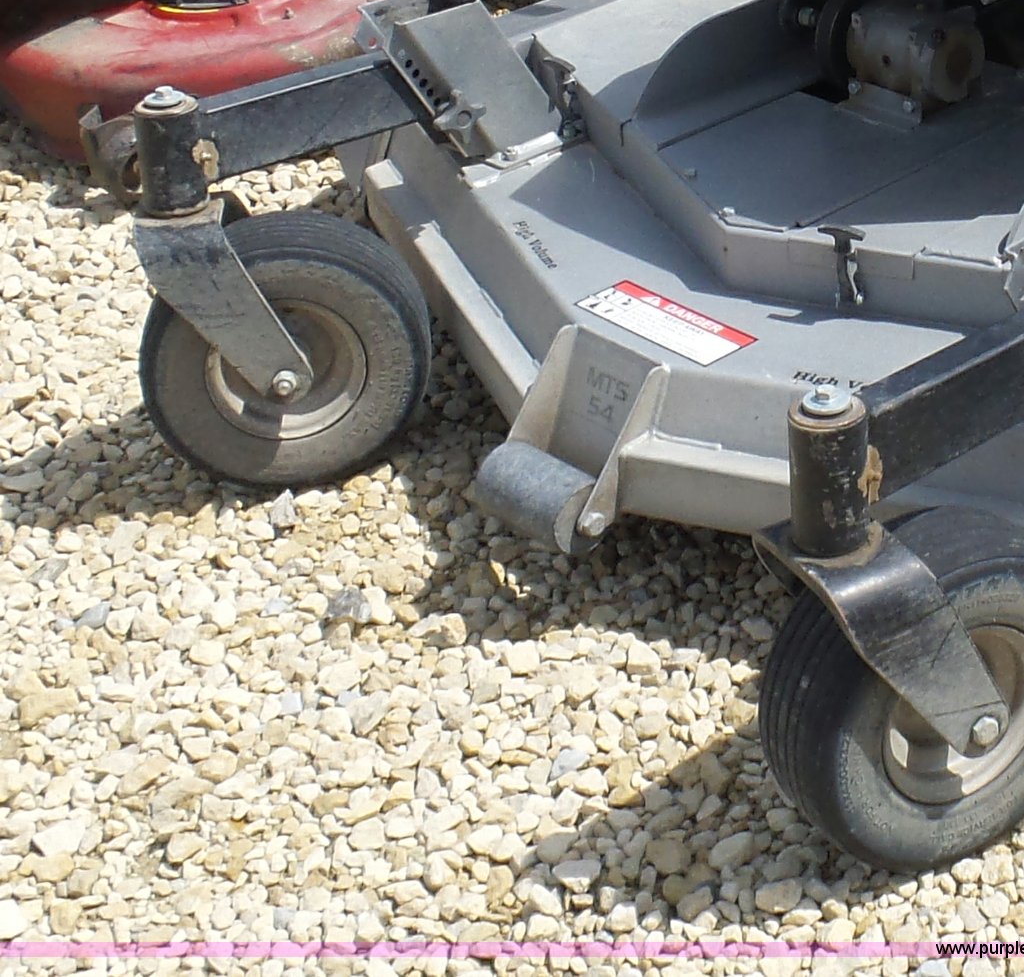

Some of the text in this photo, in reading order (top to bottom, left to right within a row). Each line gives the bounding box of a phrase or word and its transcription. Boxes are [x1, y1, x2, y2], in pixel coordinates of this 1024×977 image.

[529, 239, 558, 269] Volume
[663, 303, 724, 334] DANGER
[586, 366, 630, 402] MTS
[793, 371, 839, 386] High
[588, 395, 614, 423] 54
